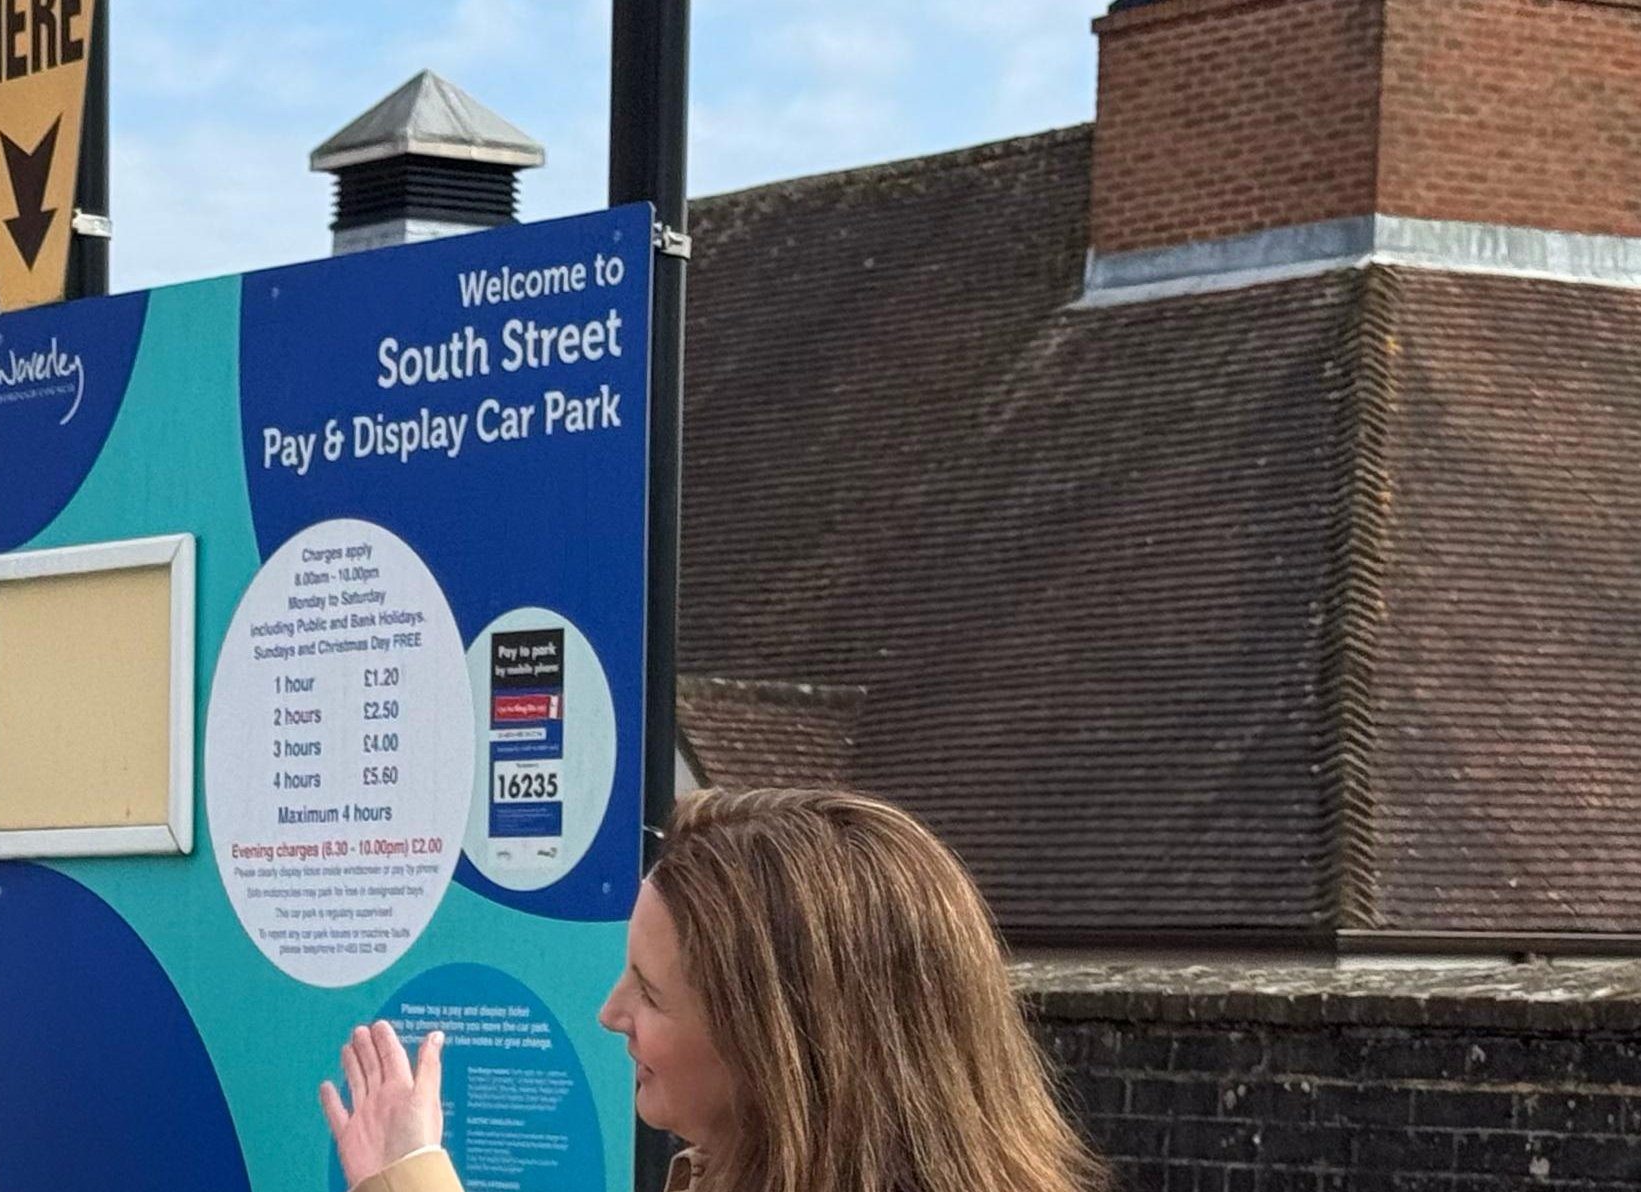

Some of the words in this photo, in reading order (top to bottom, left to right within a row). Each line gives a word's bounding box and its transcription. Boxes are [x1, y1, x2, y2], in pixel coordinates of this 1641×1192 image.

[458, 261, 586, 308] Welcome
[594, 253, 624, 287] to
[377, 326, 489, 389] South
[501, 308, 622, 372] Street
[263, 427, 316, 475] Pay
[323, 419, 345, 462] &
[353, 408, 468, 463] Display
[476, 398, 535, 443] Car
[544, 384, 621, 435] Park
[302, 548, 343, 564] Charges
[345, 543, 373, 560] apply
[288, 596, 326, 610] Monday
[328, 594, 339, 607] to
[341, 589, 386, 605] Saturday
[296, 617, 327, 633] Public
[330, 615, 348, 630] and
[350, 613, 376, 628] Bank
[254, 645, 296, 661] Sundays
[297, 641, 316, 656] and
[318, 639, 368, 654] Christmas
[370, 635, 391, 652] Day
[393, 632, 422, 648] FREE
[498, 645, 517, 661] Pay
[519, 645, 530, 657] to
[532, 641, 557, 660] park
[275, 676, 281, 694] 1
[285, 675, 315, 693] hour
[364, 667, 399, 687] £1.20
[273, 708, 282, 726] 2
[285, 707, 322, 725] hours
[363, 700, 399, 720] £2.50
[273, 740, 282, 758] 3
[285, 740, 322, 757] hours
[363, 733, 399, 752] £4.00
[273, 772, 281, 789] 4
[284, 772, 321, 789] hours
[363, 766, 398, 785] £5.60
[498, 773, 558, 799] 16235
[278, 806, 339, 824] Maximum
[342, 805, 350, 822] 4
[354, 804, 393, 821] hours
[232, 844, 273, 861] Evening
[276, 842, 319, 861] charges
[411, 838, 443, 854] £2.00
